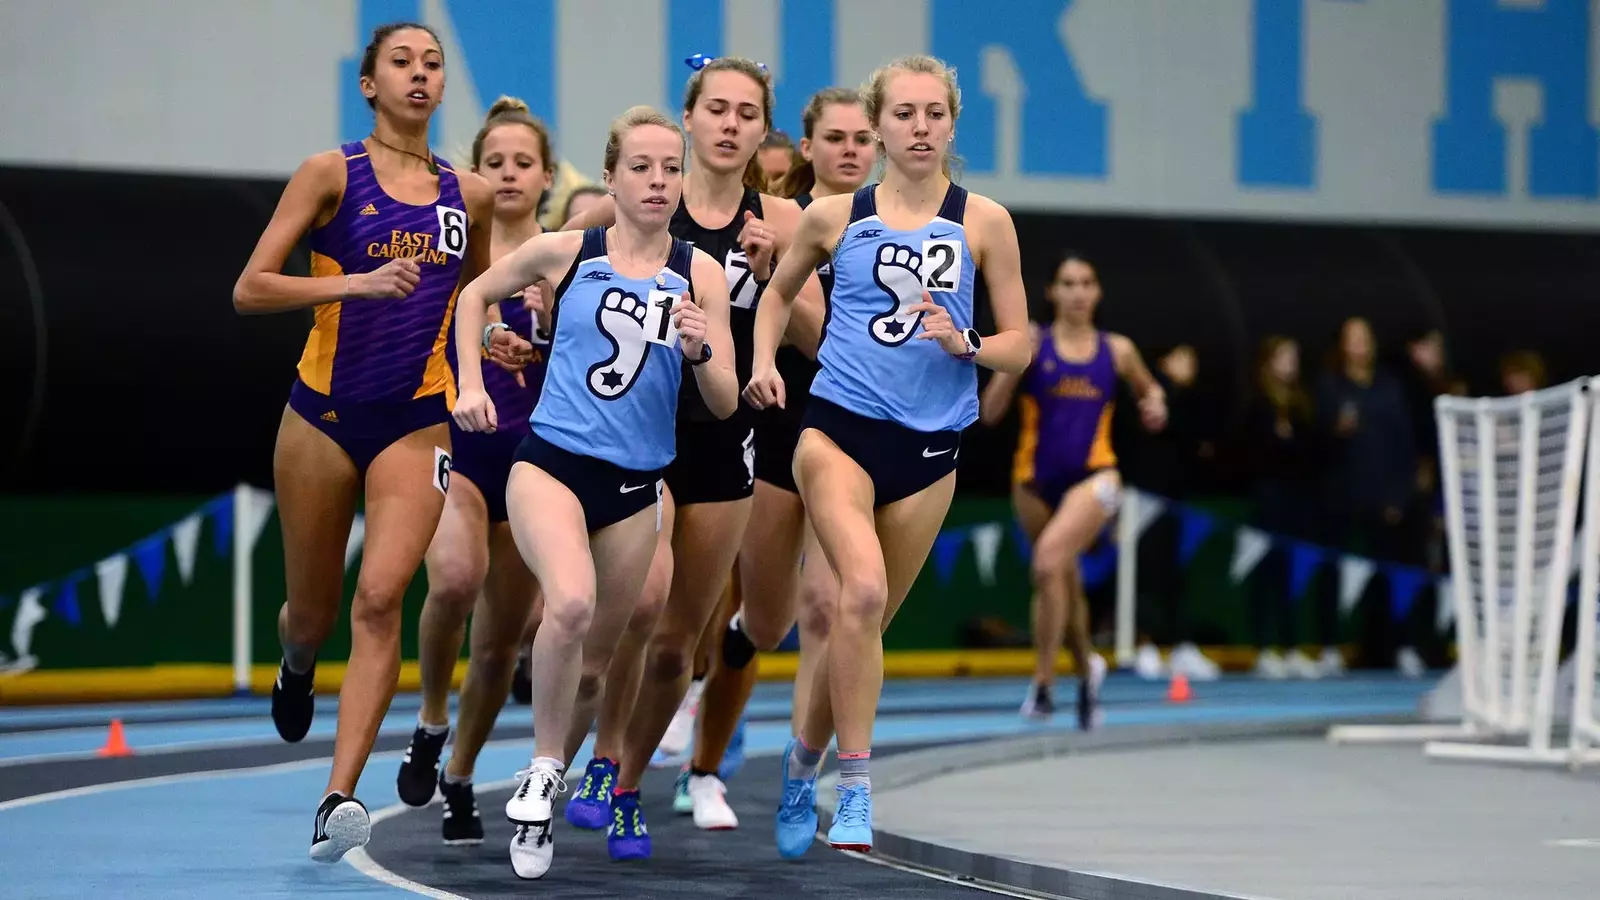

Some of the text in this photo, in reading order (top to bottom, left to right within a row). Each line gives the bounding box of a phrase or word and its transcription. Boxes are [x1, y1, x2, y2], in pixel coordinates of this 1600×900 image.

[391, 229, 432, 249] EAST
[443, 211, 463, 252] 6
[852, 229, 883, 239] ACC
[367, 242, 448, 266] CAROLINA
[927, 244, 955, 289] 2
[581, 270, 614, 281] ACC
[730, 259, 753, 302] 7
[655, 296, 674, 341] 1
[438, 454, 450, 495] 6
